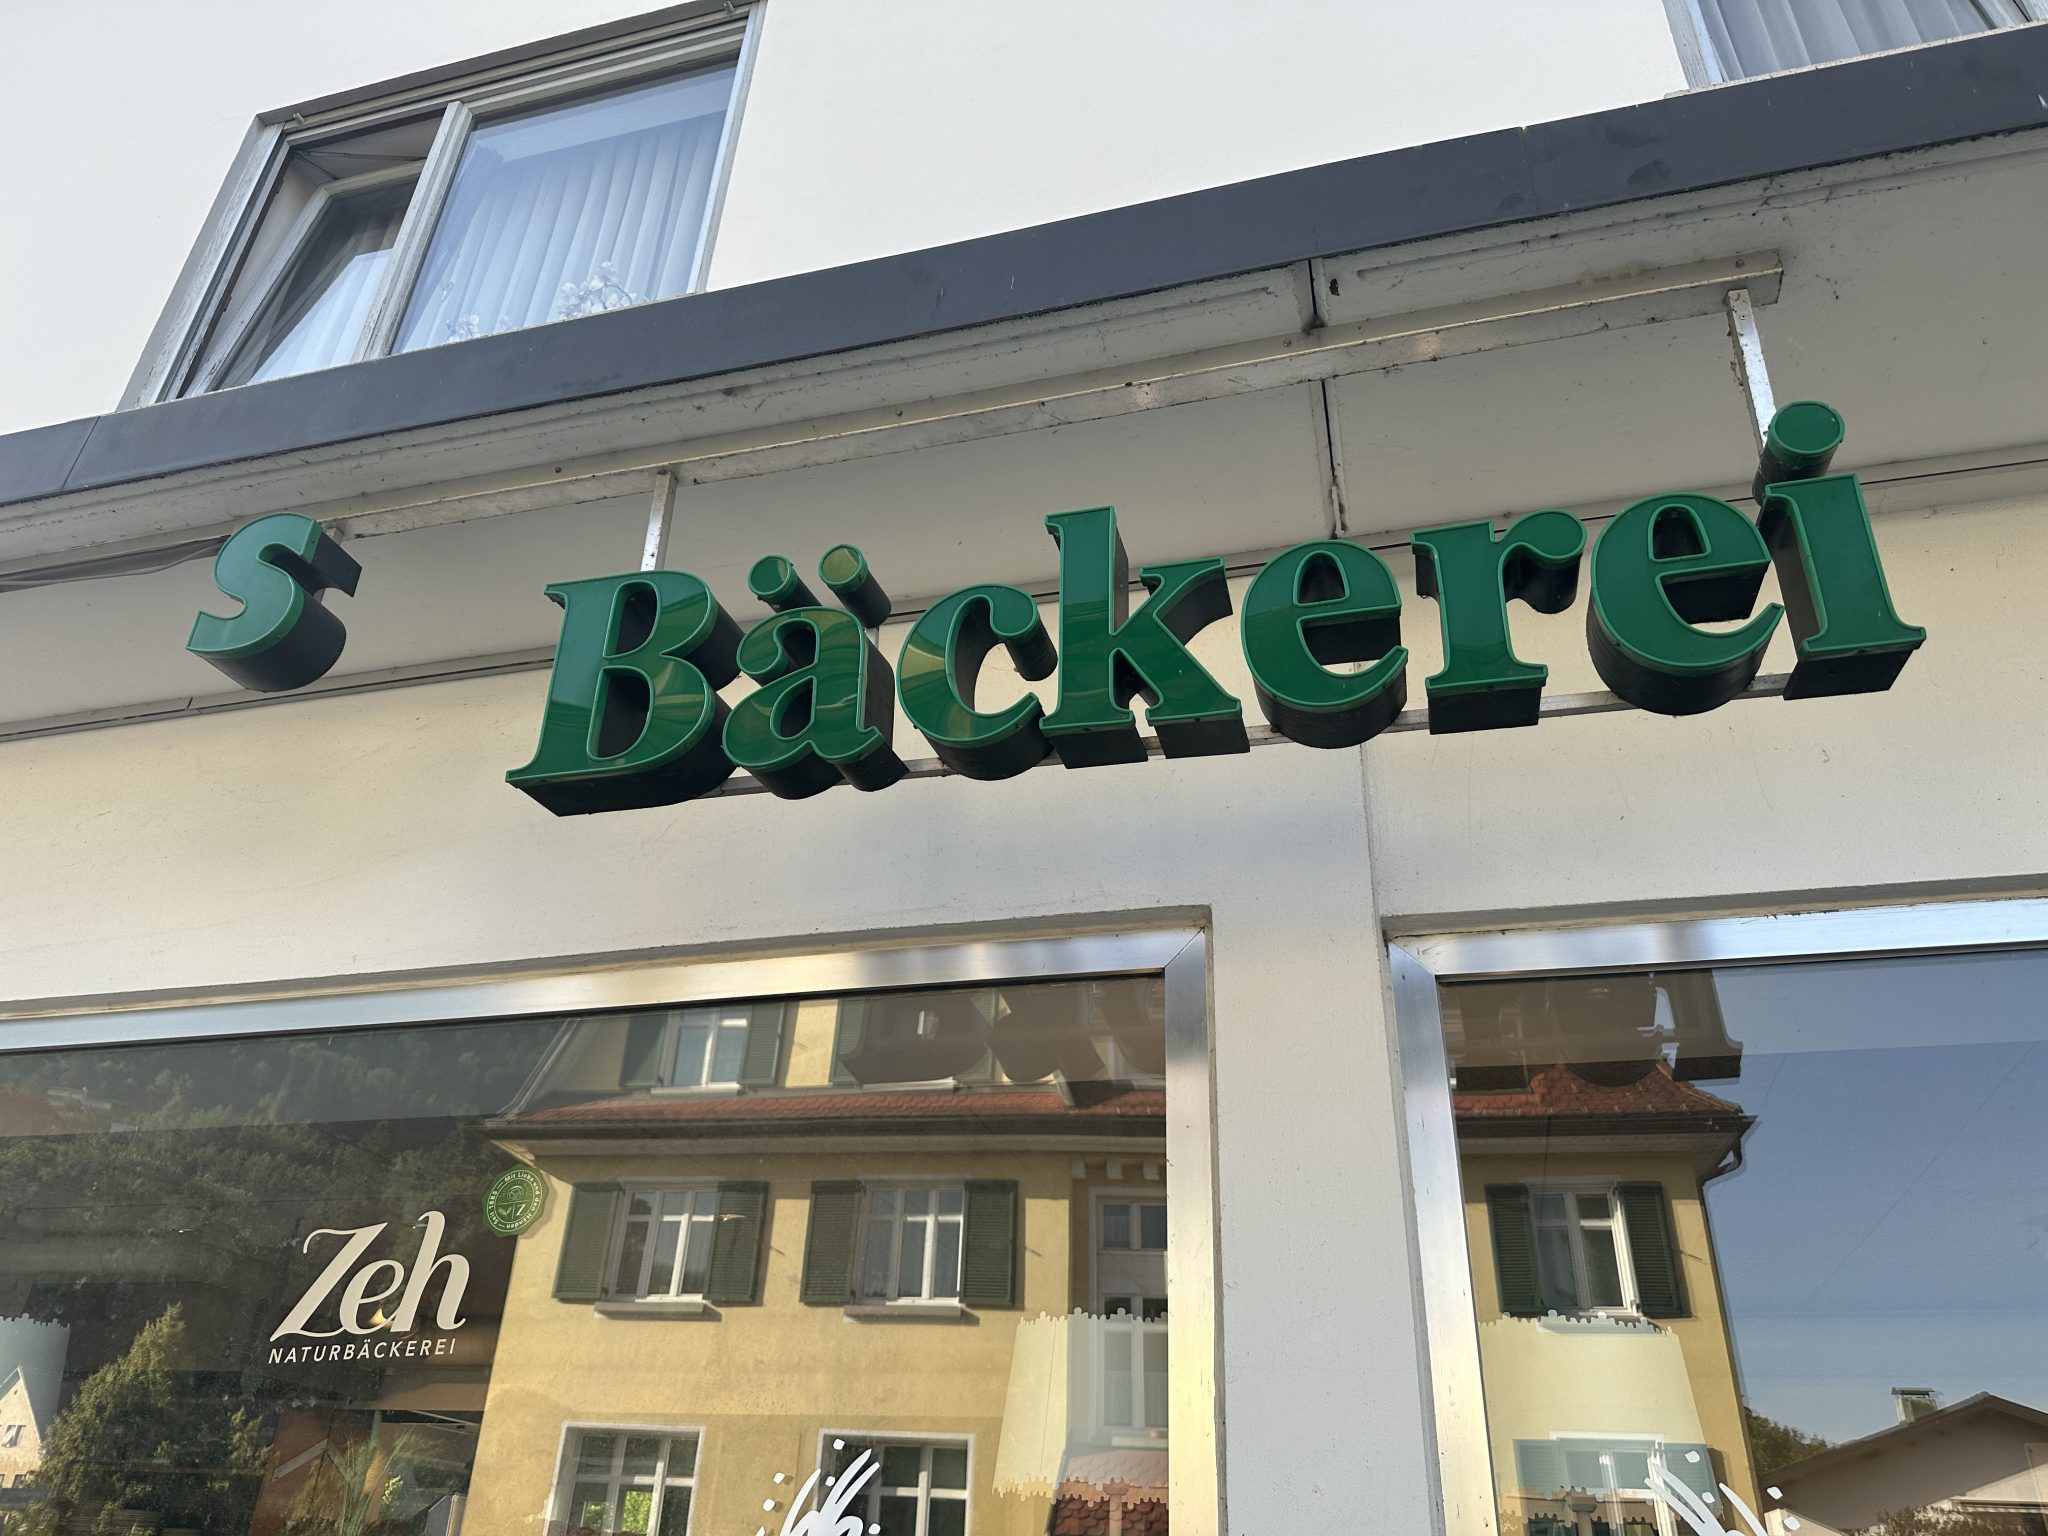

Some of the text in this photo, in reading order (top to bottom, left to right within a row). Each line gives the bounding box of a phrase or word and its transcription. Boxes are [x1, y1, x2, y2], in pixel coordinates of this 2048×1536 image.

[505, 402, 1927, 792] Bäckerei
[504, 1174, 516, 1182] Mit
[517, 1172, 534, 1182] Liebe
[533, 1182, 541, 1195] und
[515, 1203, 526, 1216] Z
[531, 1197, 540, 1211] den
[490, 1212, 499, 1225] Seit
[270, 1210, 470, 1342] Zeh
[268, 1337, 457, 1365] NATURBÄCKEREI
